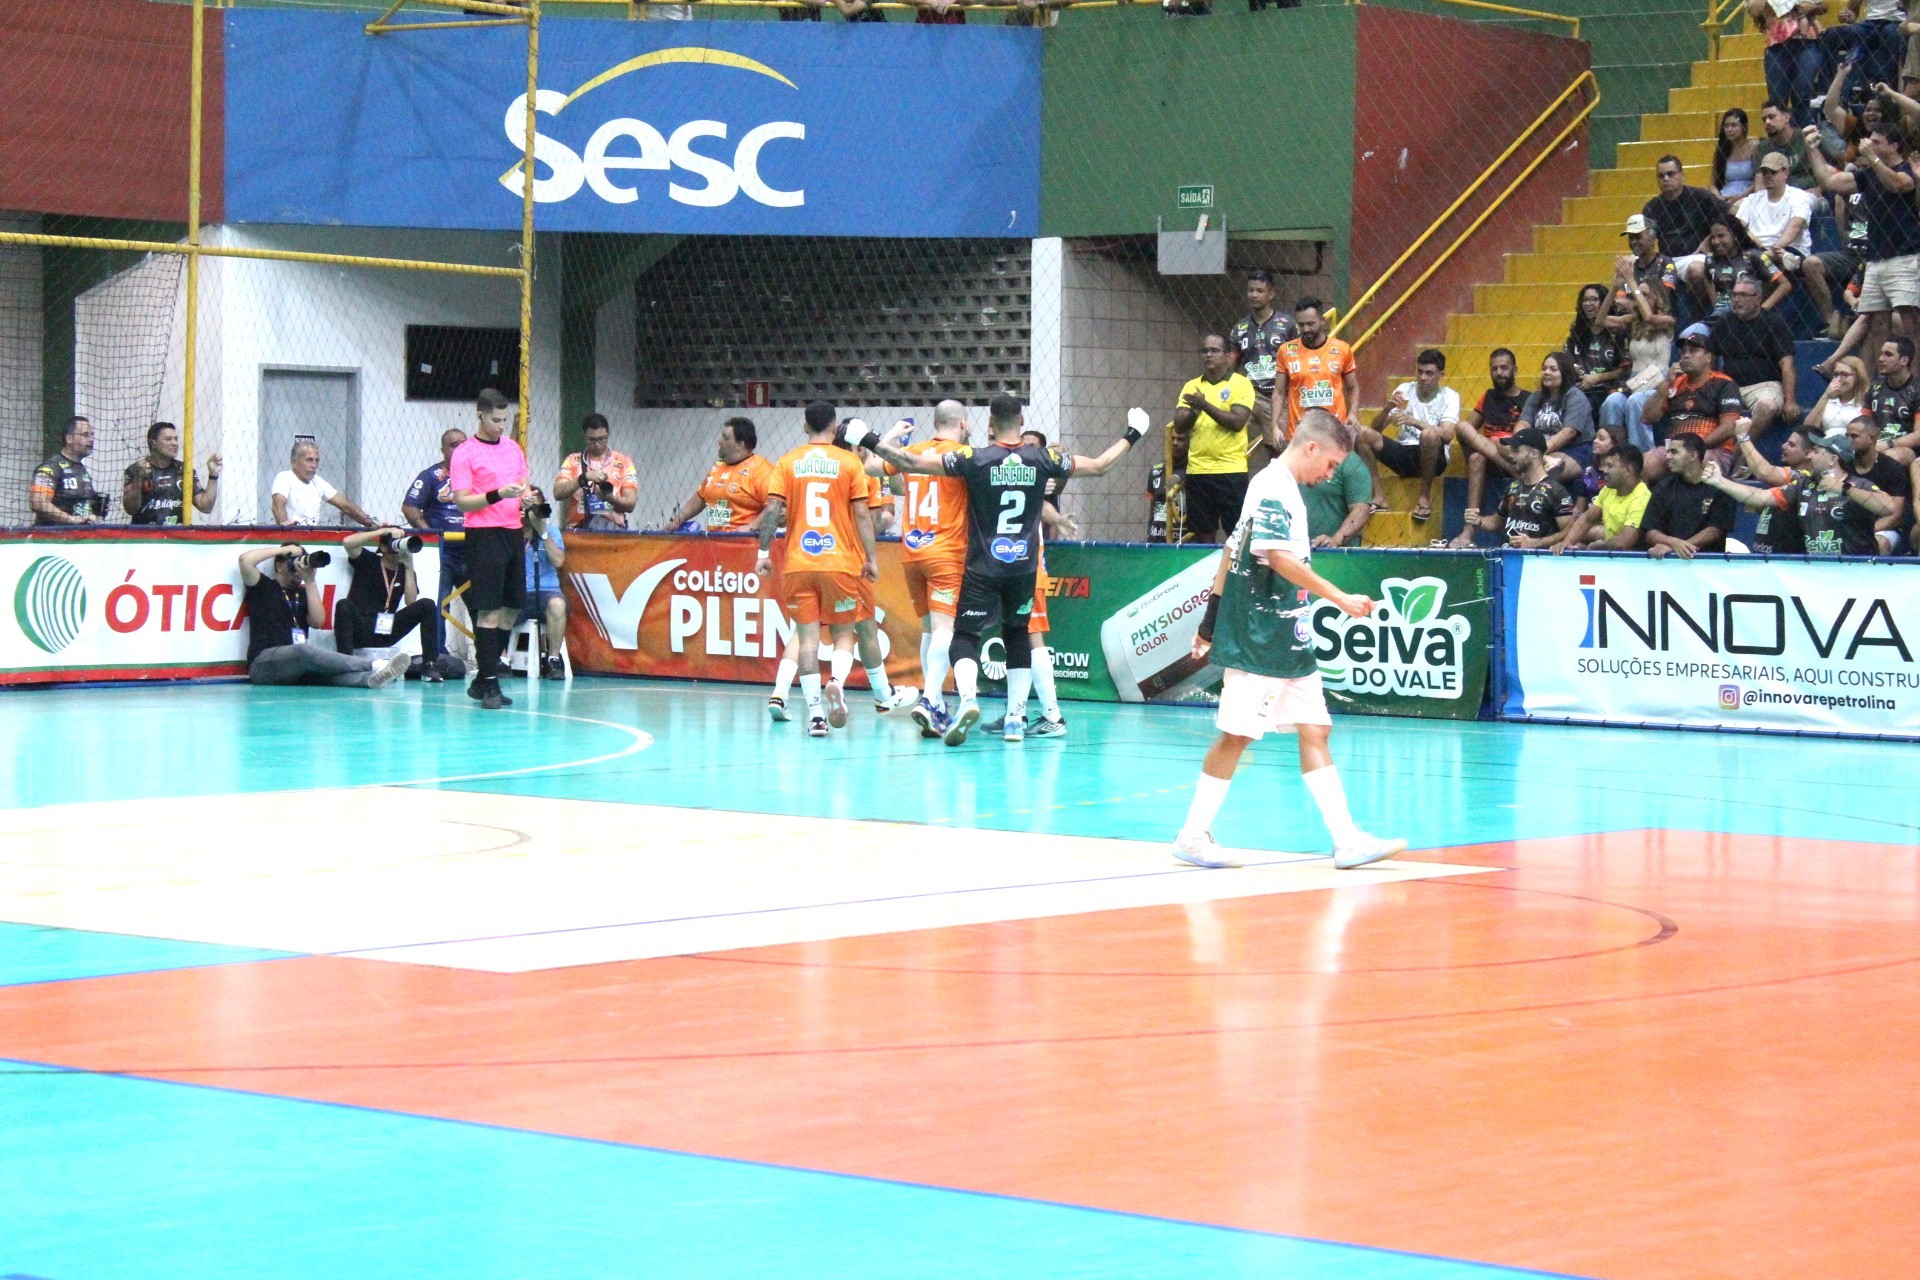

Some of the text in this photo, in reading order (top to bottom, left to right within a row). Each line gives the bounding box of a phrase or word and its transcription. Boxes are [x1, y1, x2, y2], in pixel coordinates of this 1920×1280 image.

[500, 89, 805, 207] Sesc
[1180, 190, 1202, 203] SAÍDA
[1288, 361, 1301, 374] 10
[1300, 387, 1333, 399] Seiva
[63, 477, 78, 490] 10
[805, 482, 831, 528] 6
[908, 481, 940, 525] 14
[997, 490, 1026, 534] 2
[804, 538, 833, 547] EMS
[995, 544, 1025, 554] EMS
[673, 566, 760, 594] COLÉGIO
[1130, 575, 1218, 646] PHYSIOGRO
[1135, 632, 1169, 657] COLOR
[1312, 606, 1456, 667] Seiva
[1352, 667, 1457, 691] DO VALE
[1577, 657, 1662, 679] SOLUÇÕES
[1666, 661, 1790, 685] EMPRESARIAIS,
[1793, 667, 1834, 686] AQUI
[1743, 688, 1896, 711] @innovarepetrolina
